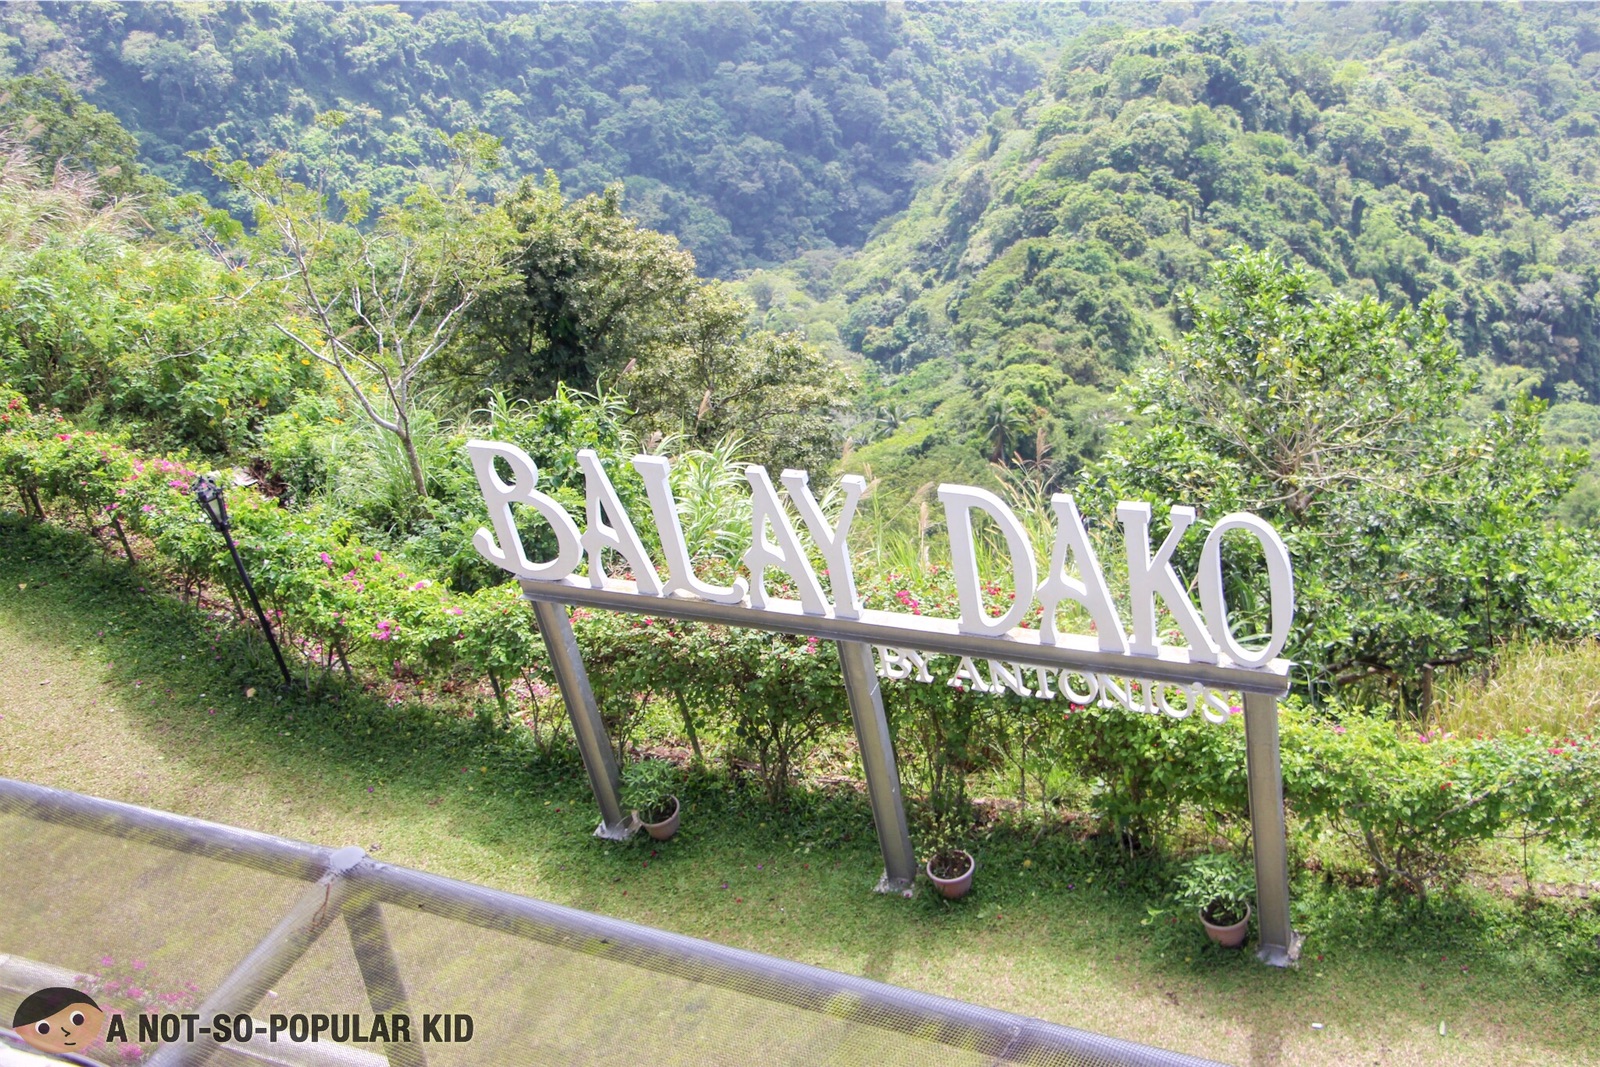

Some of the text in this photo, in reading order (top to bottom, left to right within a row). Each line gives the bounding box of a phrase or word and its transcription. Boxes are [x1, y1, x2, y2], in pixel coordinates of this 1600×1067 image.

[467, 440, 1294, 668] BALAY DAKO
[876, 645, 1230, 724] BY ANTONIO'S
